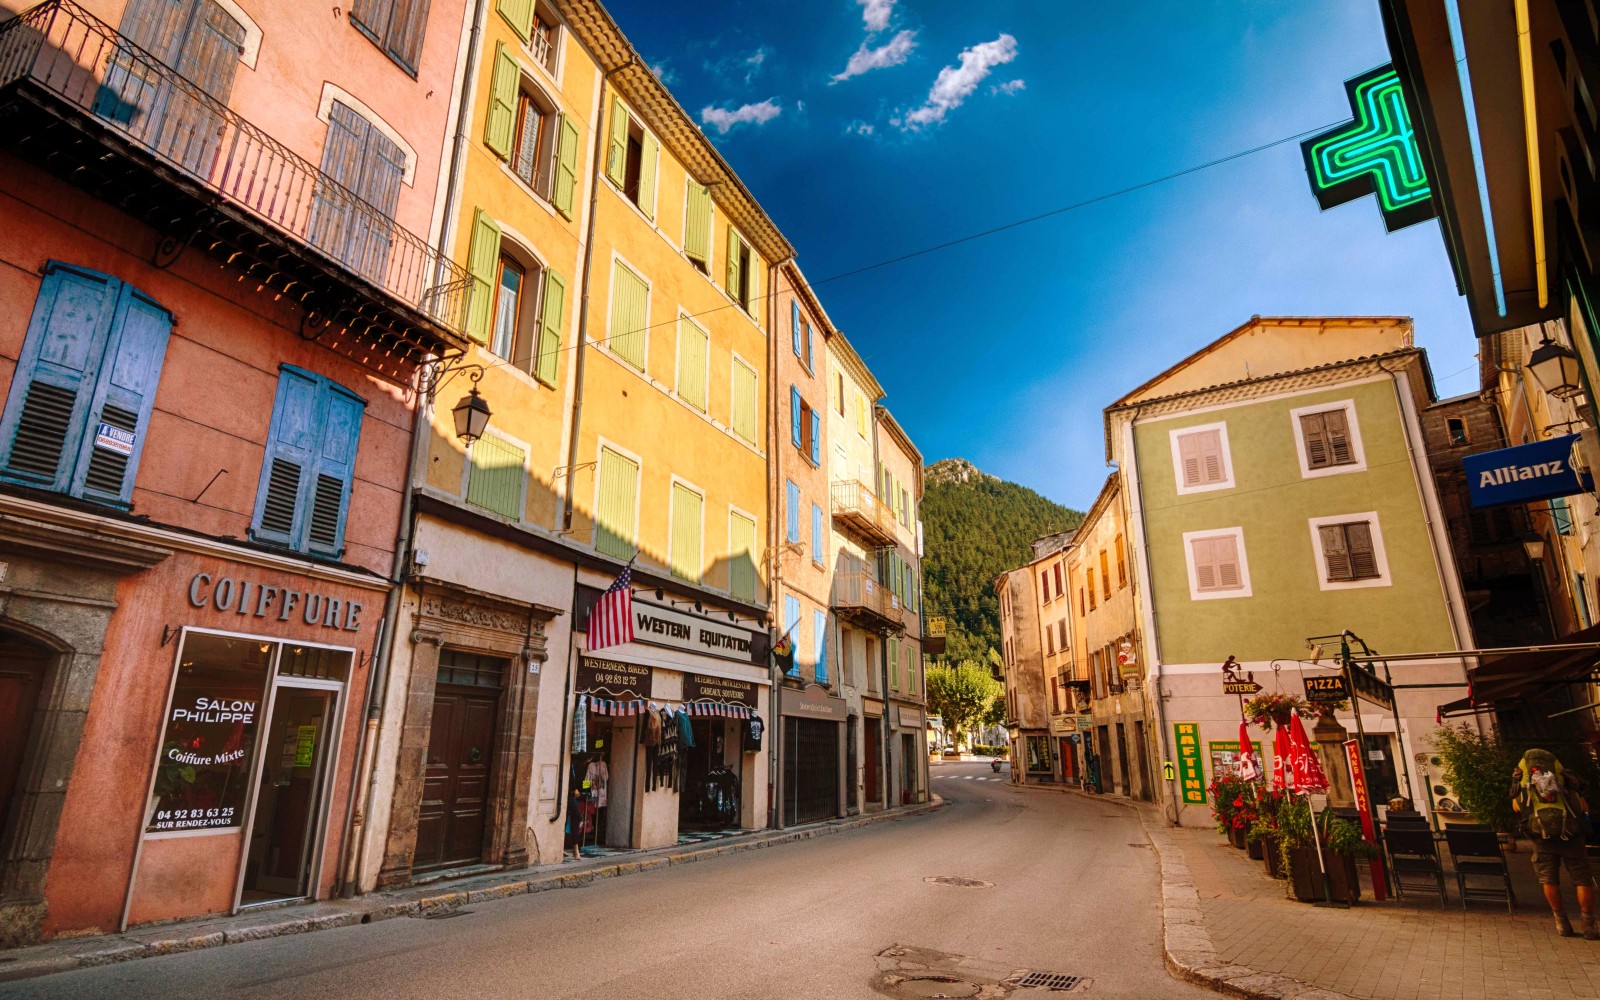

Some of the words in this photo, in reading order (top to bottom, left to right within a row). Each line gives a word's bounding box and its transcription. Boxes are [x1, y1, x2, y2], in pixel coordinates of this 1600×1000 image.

[109, 427, 134, 444] VENDRE
[1479, 460, 1565, 488] Allianz
[189, 572, 363, 632] COIFFURE
[637, 613, 691, 640] WESTERN
[699, 628, 752, 654] EQUITATION
[584, 657, 627, 673] WESTERNERS,
[1223, 683, 1257, 693] POTERIE
[1306, 679, 1343, 690] PIZZA
[195, 697, 255, 712] SALON
[172, 709, 253, 724] PHILIPPE
[168, 748, 211, 765] Coiffure
[214, 749, 245, 764] Mixte
[1178, 724, 1202, 801] RAFTING
[1349, 745, 1360, 774] TAKE
[1356, 778, 1367, 812] AWAY
[157, 811, 171, 820] 04
[174, 810, 187, 819] 92
[190, 809, 203, 818] 83
[206, 808, 219, 817] 63
[221, 807, 234, 816] 25
[156, 821, 174, 829] SUR
[175, 818, 231, 828] RENDEZ-VOUS
